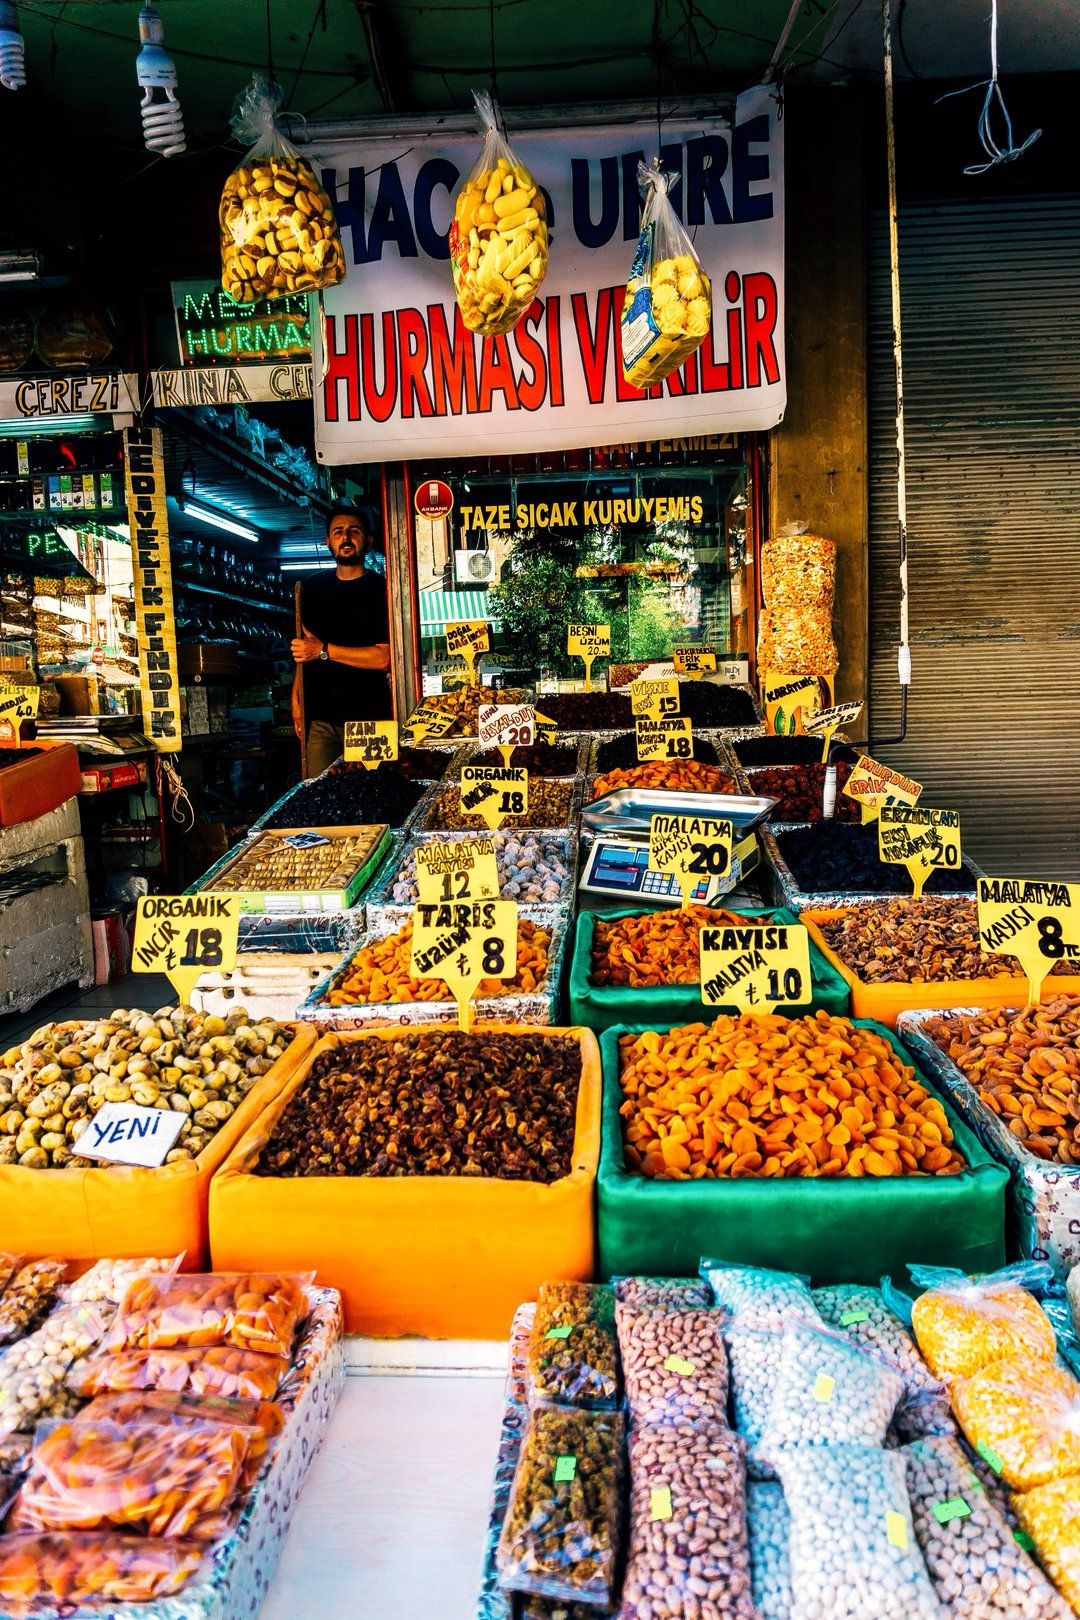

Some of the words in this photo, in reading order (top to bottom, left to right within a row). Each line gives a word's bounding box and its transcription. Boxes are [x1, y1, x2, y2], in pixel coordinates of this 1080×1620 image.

[324, 294, 565, 424] HURMASI
[15, 373, 119, 417] ÇEREZİ
[460, 504, 510, 531] TAZE
[516, 501, 577, 528] SICAK
[584, 495, 704, 525] KURUYEMİŞ
[631, 680, 670, 697] VİŞNE
[658, 696, 679, 713] 15
[345, 721, 376, 737] KAN
[425, 722, 447, 734] 25
[479, 713, 514, 742] BEYAZ
[510, 705, 535, 727] DUT
[508, 726, 531, 745] 20
[637, 718, 687, 734] MALATYA
[361, 745, 384, 761] 12
[665, 736, 692, 758] 18
[849, 776, 888, 796] ERİK
[497, 791, 525, 814] 18
[653, 815, 732, 839] MALATYA
[416, 838, 495, 865] MALATYA
[655, 834, 693, 869] KAYISI
[687, 842, 729, 876] 20
[929, 841, 958, 867] 20
[439, 870, 472, 902] 12
[980, 880, 1072, 907] MALATYA
[702, 928, 789, 951] KAYISI
[981, 905, 1036, 950] KAYISI
[1036, 915, 1065, 959] 8
[179, 927, 223, 967] 18
[481, 936, 505, 975] 8
[702, 950, 769, 1004] MALATYA
[764, 967, 803, 1002] 10
[92, 1111, 163, 1148] YENİ
